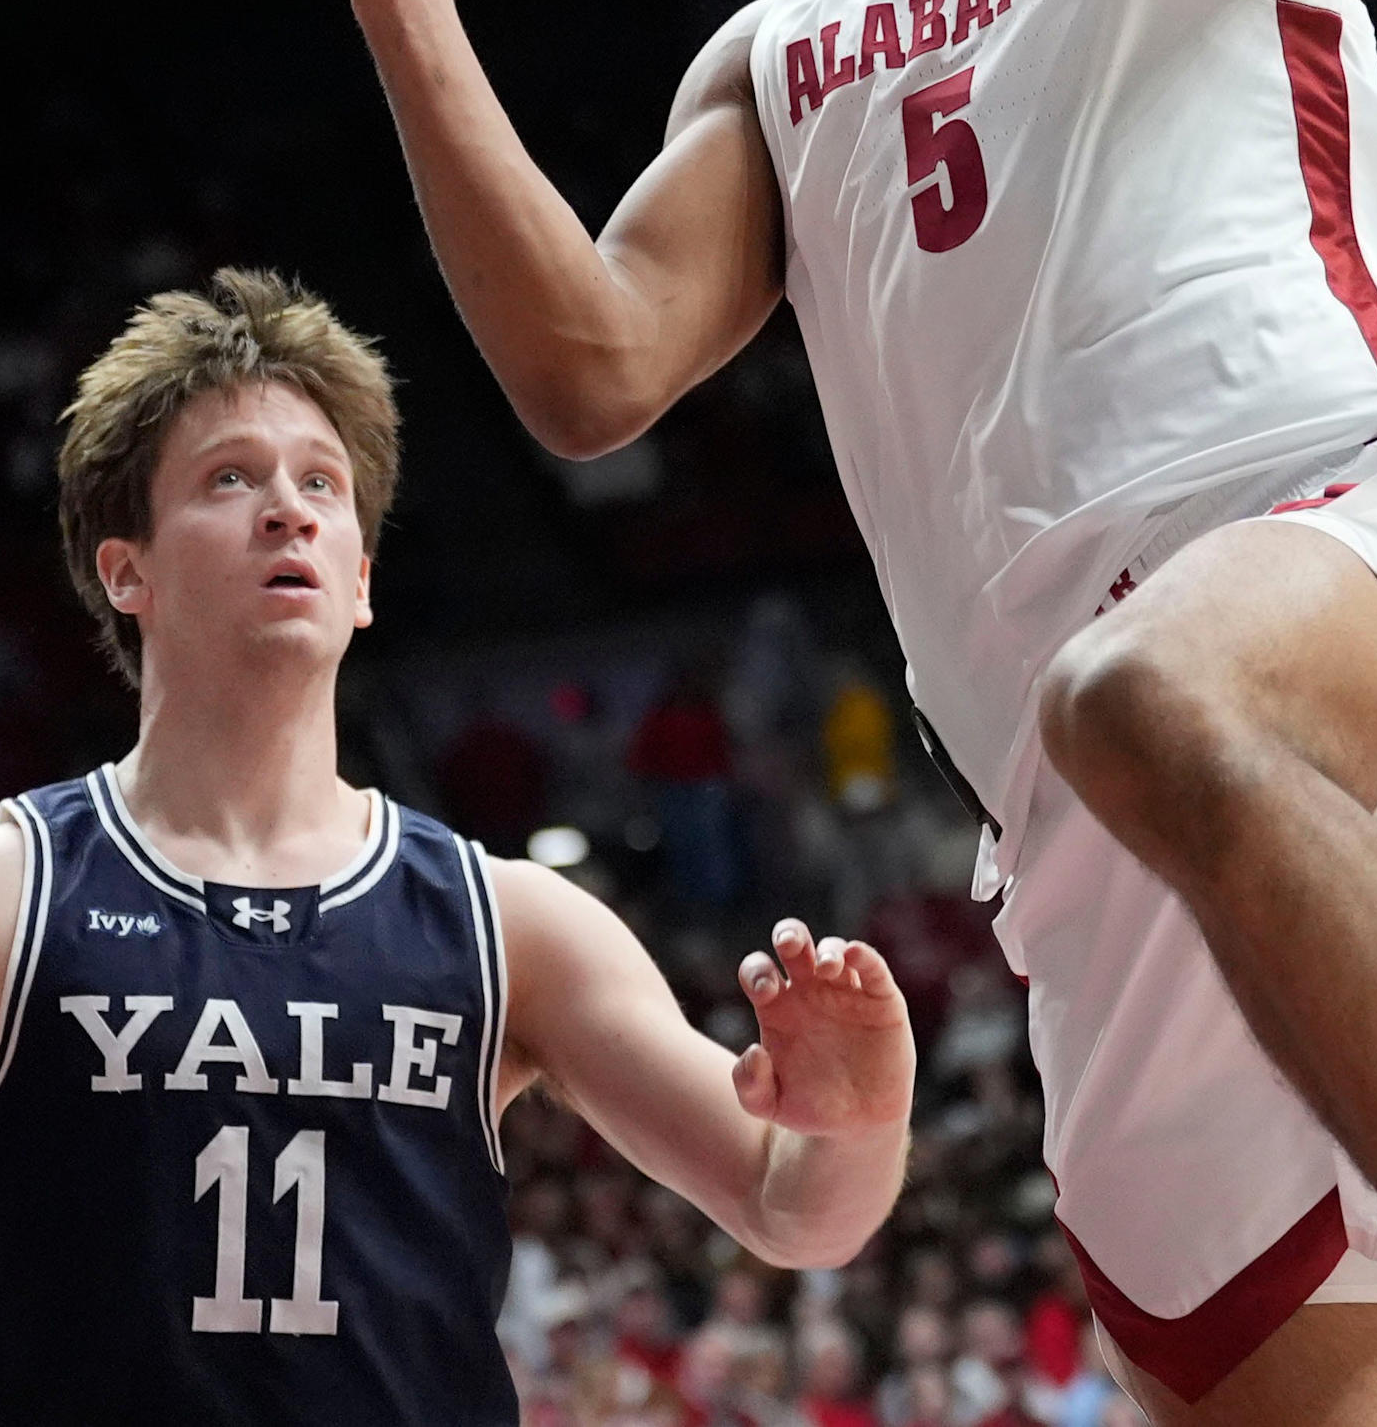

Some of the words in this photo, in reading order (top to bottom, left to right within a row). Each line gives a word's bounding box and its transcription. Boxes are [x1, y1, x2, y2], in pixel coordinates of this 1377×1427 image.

[901, 65, 990, 254] 5
[88, 909, 136, 937] Ivy
[59, 995, 463, 1110] YALE
[191, 1125, 340, 1336] 11
